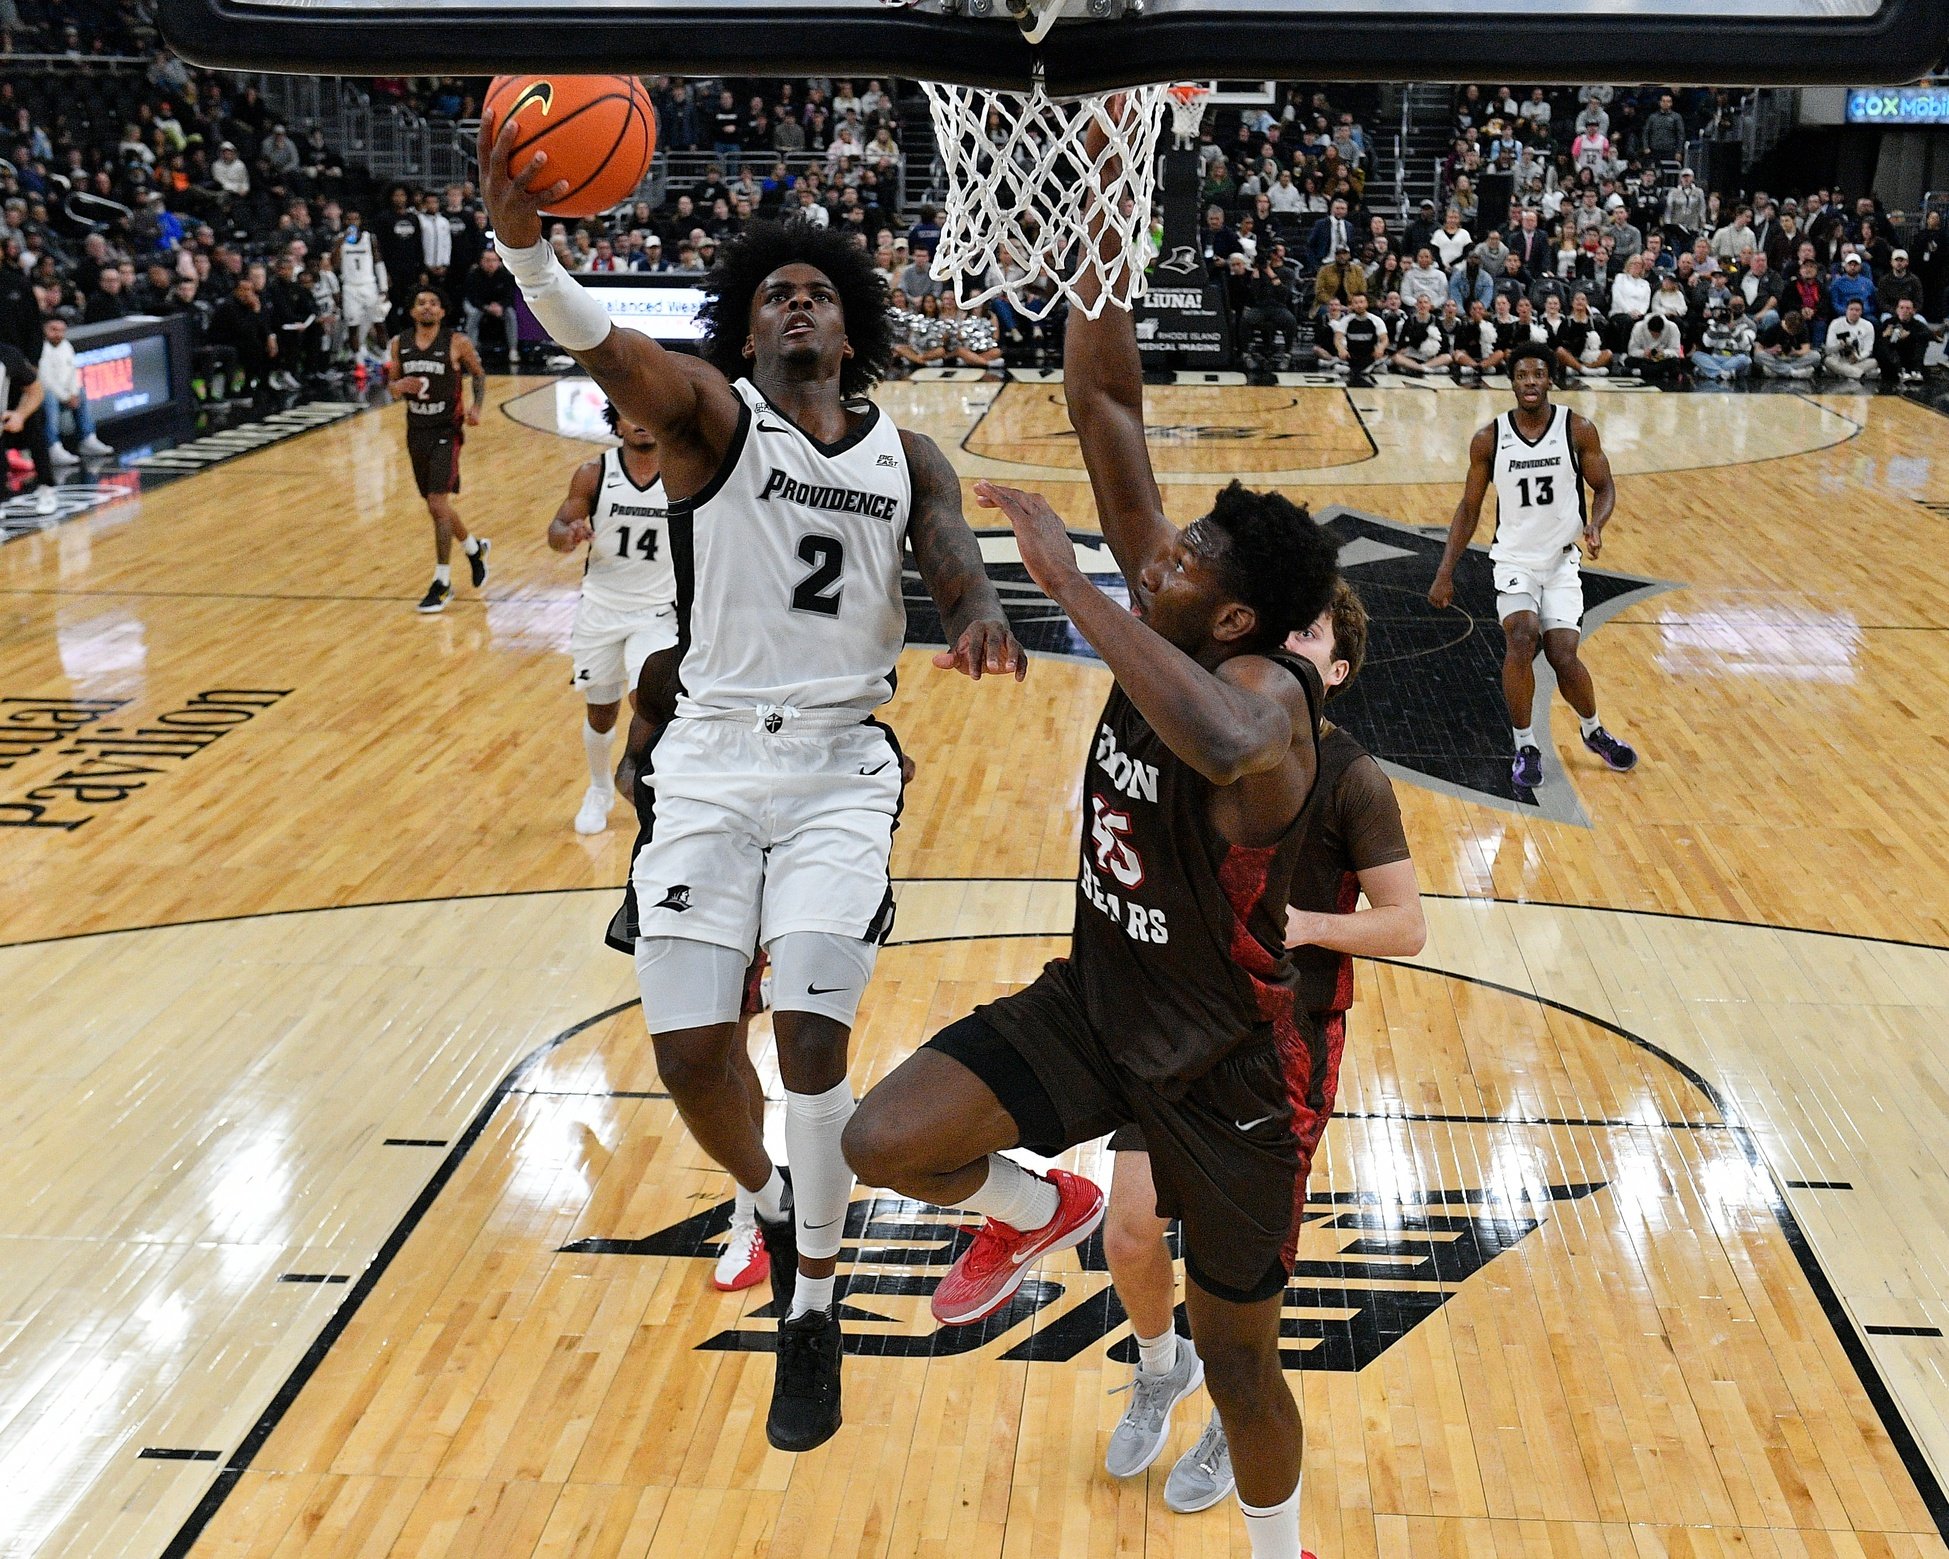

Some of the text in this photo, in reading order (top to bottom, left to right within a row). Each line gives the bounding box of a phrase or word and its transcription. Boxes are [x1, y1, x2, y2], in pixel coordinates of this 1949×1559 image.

[1851, 96, 1899, 116] COX
[602, 299, 662, 313] alanced
[1157, 332, 1221, 341] RHODE ISLAND
[1178, 343, 1221, 352] IMAGING
[417, 376, 430, 400] 2
[1508, 456, 1562, 472] PROVIDENCE
[756, 466, 899, 523] PROVIDENCE
[1515, 476, 1554, 507] 13
[609, 503, 668, 518] PROVIDENC
[615, 525, 659, 562] 14
[788, 531, 847, 620] 2
